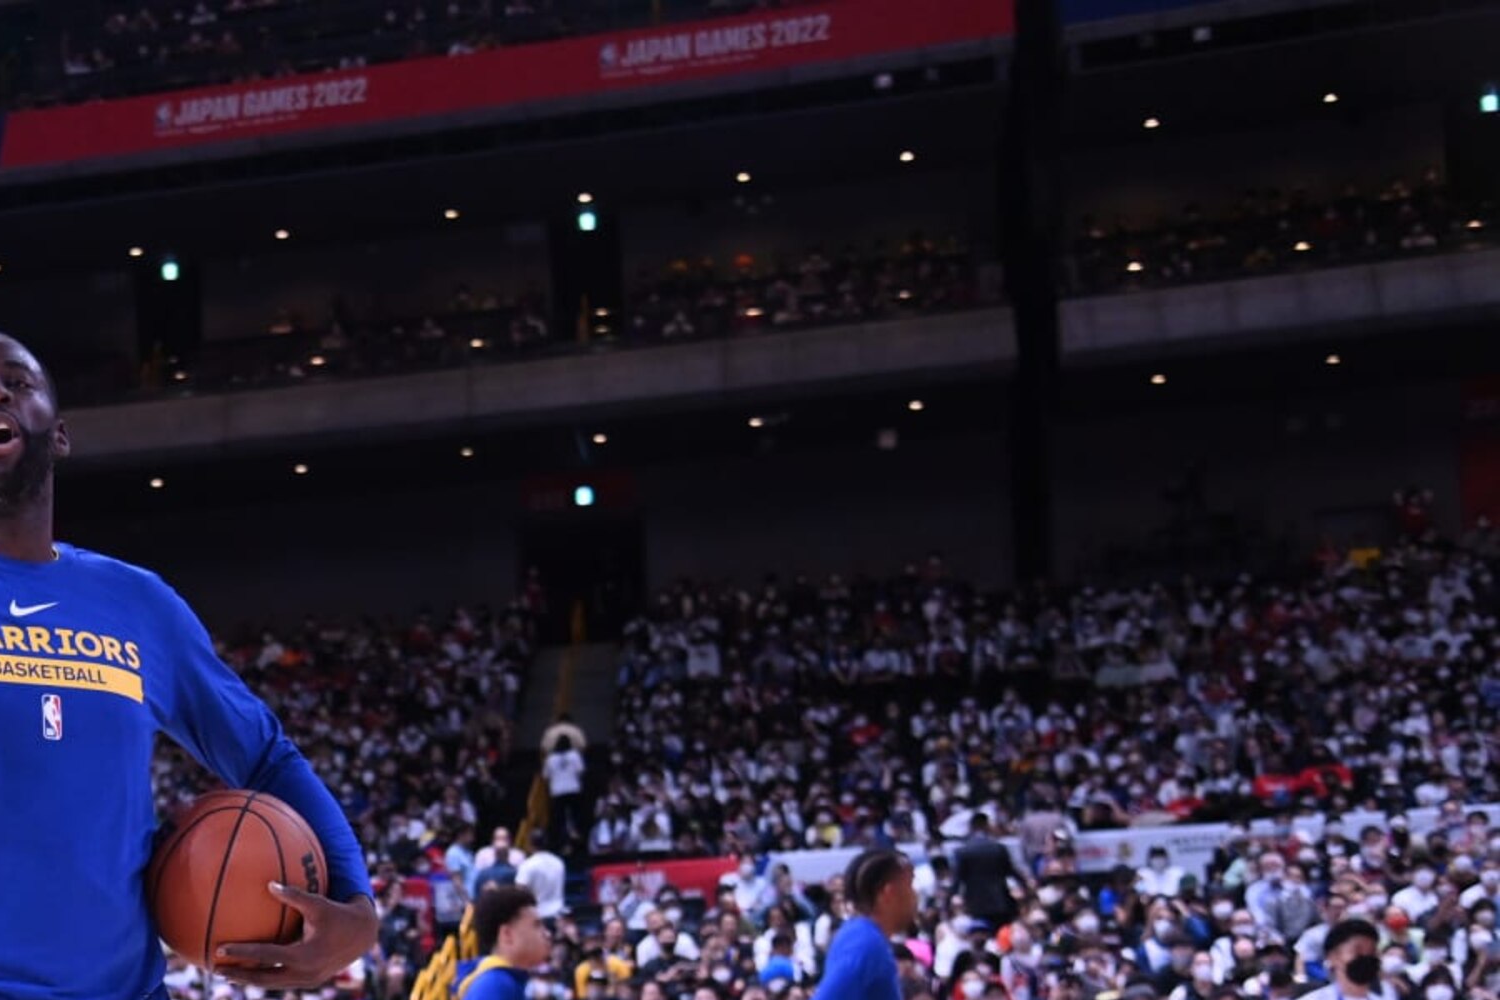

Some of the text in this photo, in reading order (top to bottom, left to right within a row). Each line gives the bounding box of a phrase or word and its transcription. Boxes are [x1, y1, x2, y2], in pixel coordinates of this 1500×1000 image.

[620, 31, 692, 67] JAPAN
[695, 22, 766, 57] GAMES
[769, 13, 832, 47] 2022
[174, 93, 240, 126] JAPAN
[243, 84, 309, 117] GAMES
[312, 77, 369, 108] 2022
